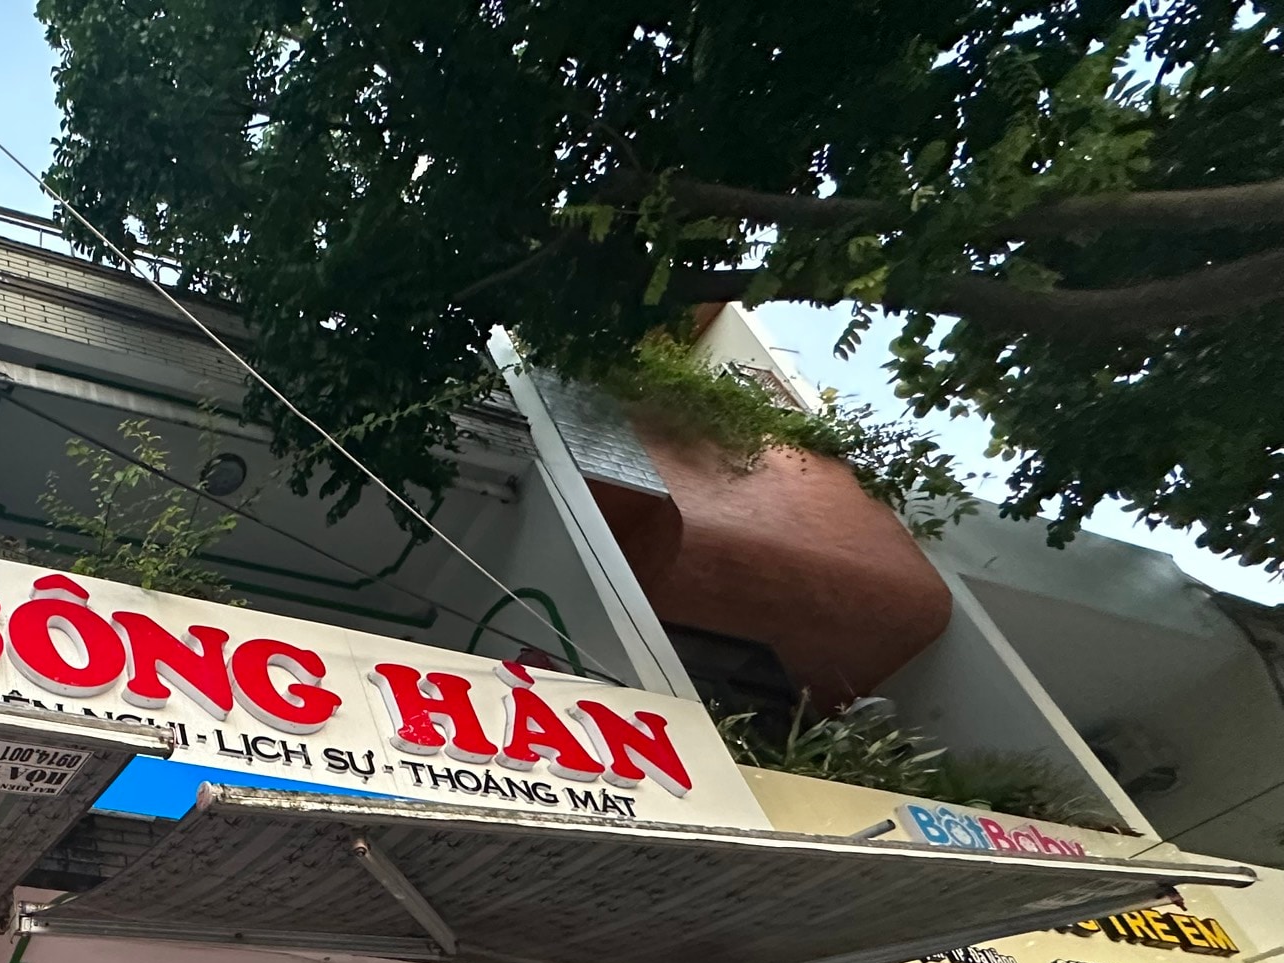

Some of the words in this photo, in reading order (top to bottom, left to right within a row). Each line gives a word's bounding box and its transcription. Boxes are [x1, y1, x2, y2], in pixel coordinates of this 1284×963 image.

[368, 658, 694, 797] HÀN
[216, 729, 313, 766] LỊCH
[321, 747, 376, 783] SỰ
[399, 759, 559, 805] THOÁNG
[565, 787, 637, 818] MÁT
[1170, 912, 1240, 954] EM
